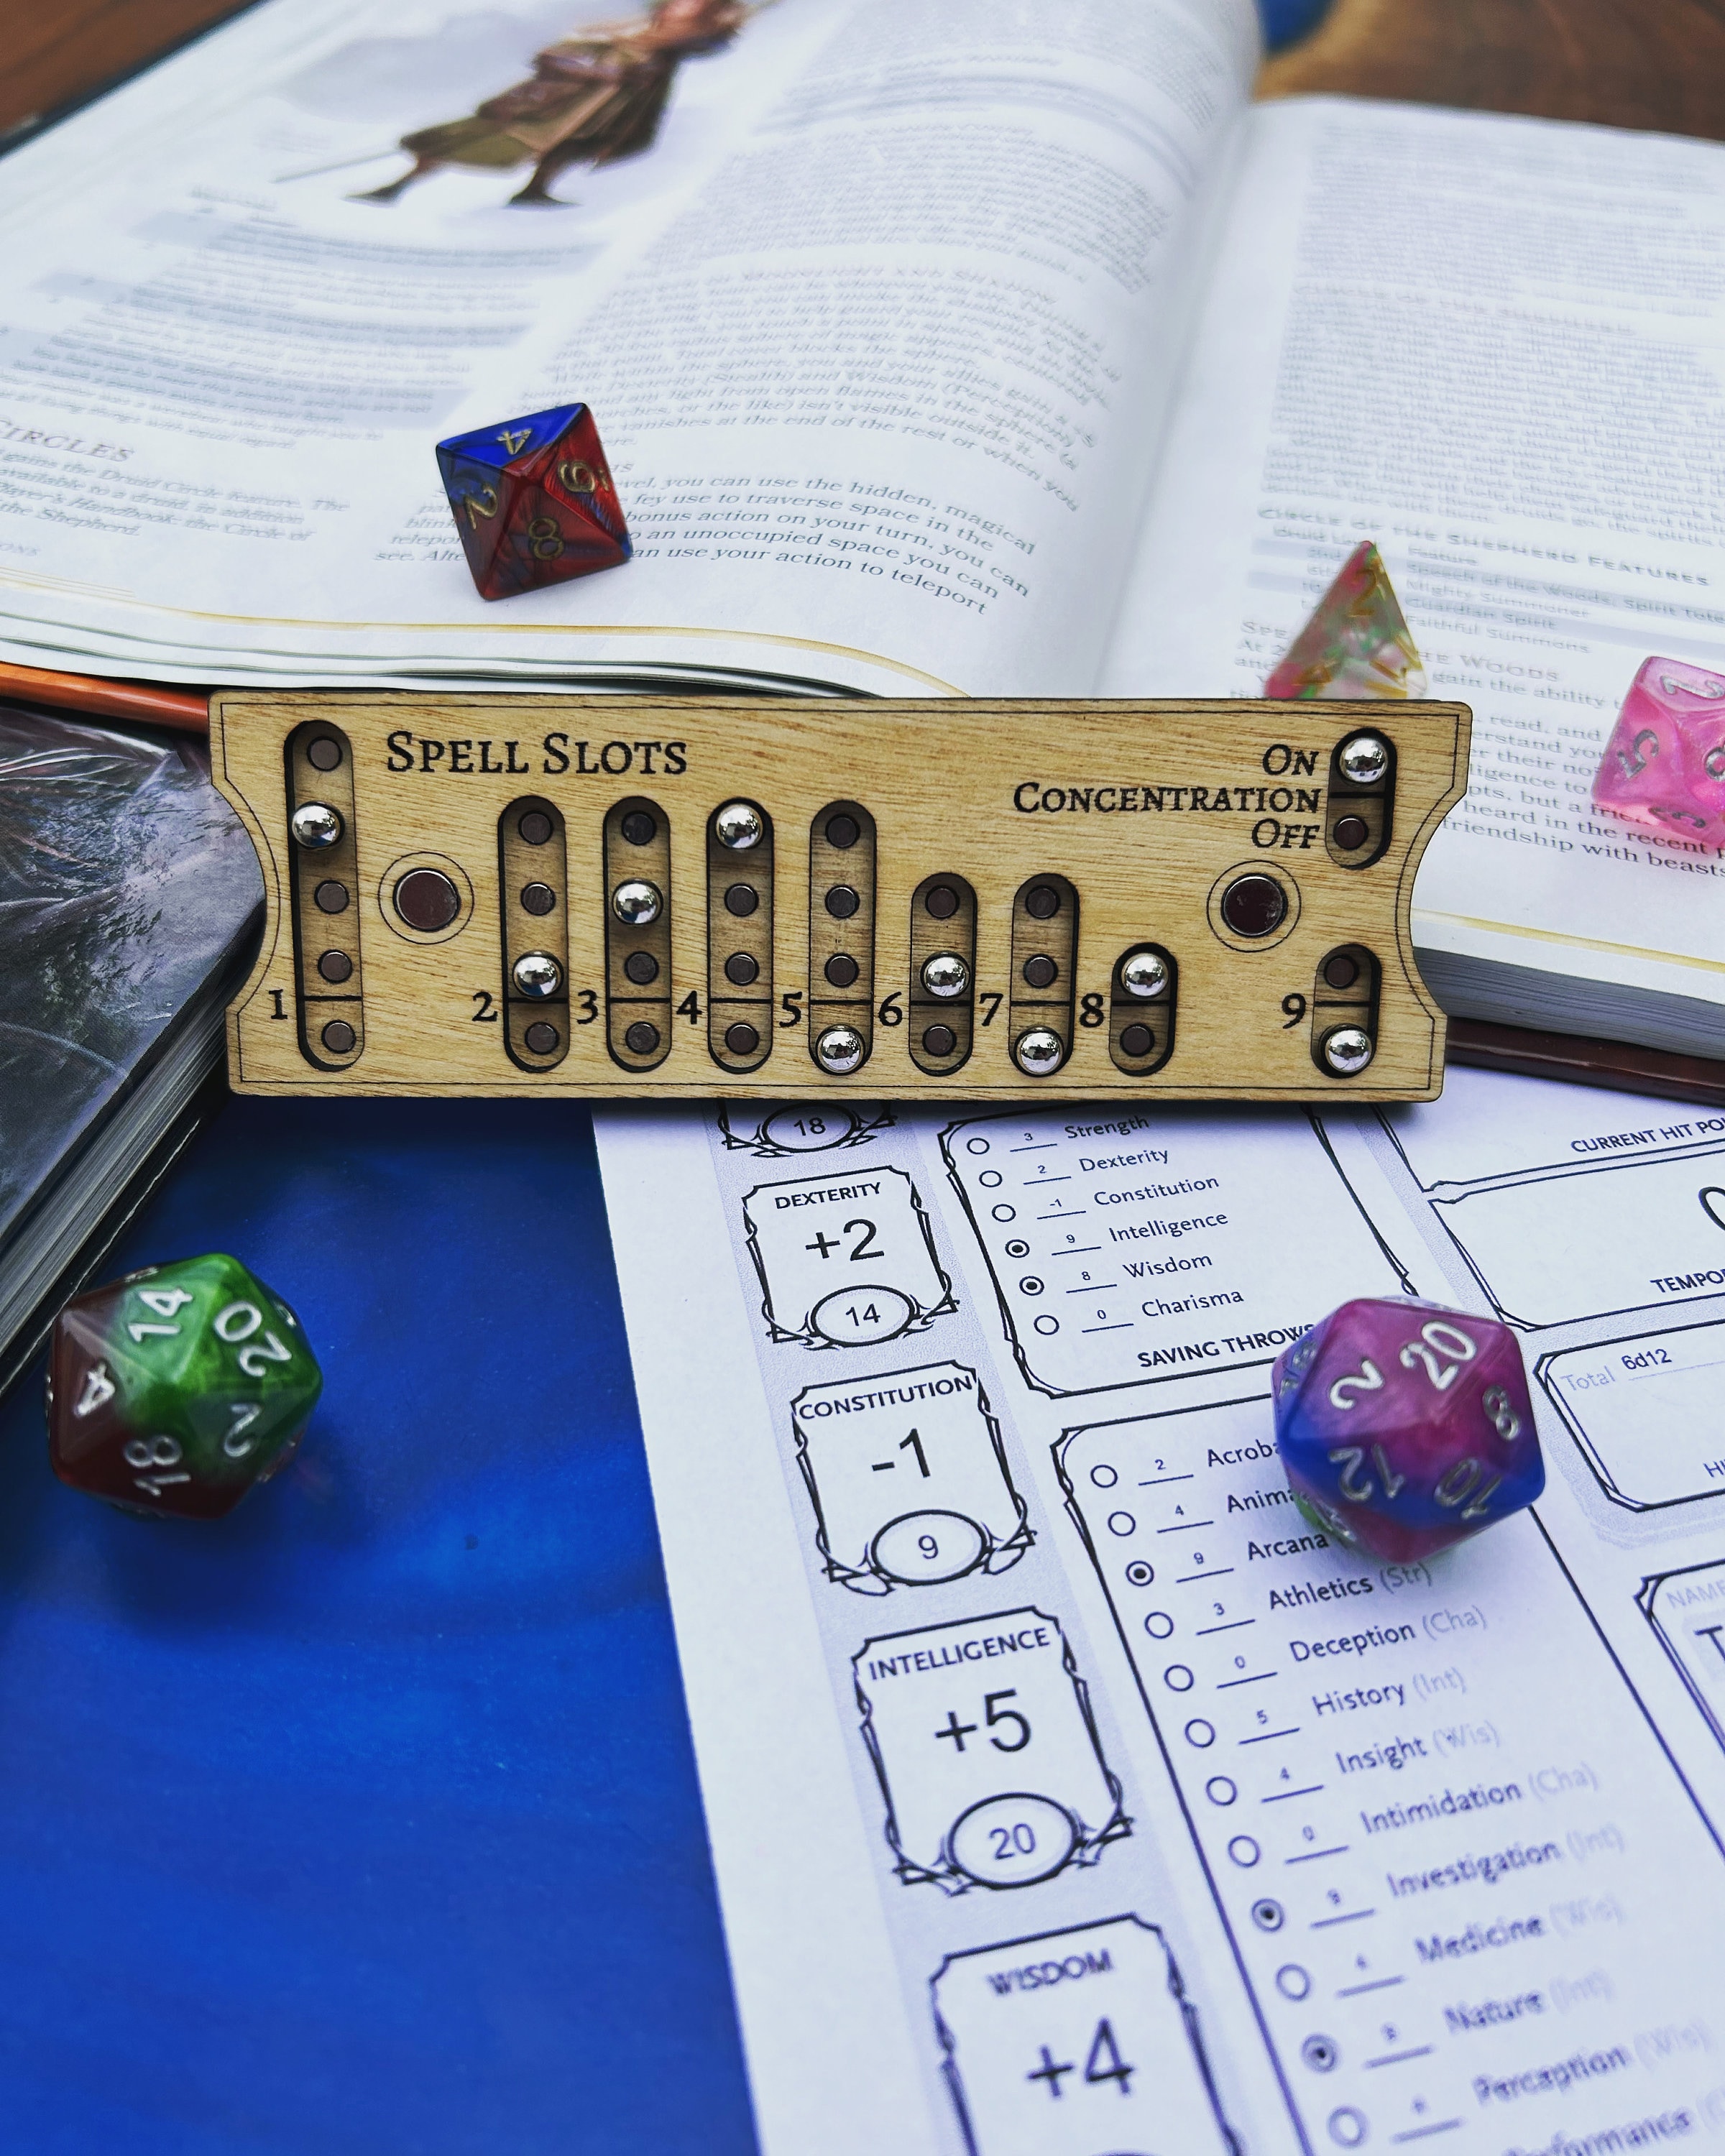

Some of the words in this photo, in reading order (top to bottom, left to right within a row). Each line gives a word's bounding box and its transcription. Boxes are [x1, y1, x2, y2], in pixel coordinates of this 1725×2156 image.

[837, 385, 909, 402] flames
[944, 396, 982, 416] the
[495, 428, 534, 456] 4
[851, 400, 924, 420] visible
[927, 413, 1011, 446] outside
[742, 415, 778, 426] the
[783, 415, 826, 426] end
[859, 417, 896, 433] the
[901, 423, 947, 443] rest
[983, 445, 1043, 482] when
[463, 485, 498, 530] 2
[632, 493, 667, 507] fey
[671, 494, 712, 505] use
[717, 494, 741, 505] to
[745, 494, 845, 510] traverse
[849, 502, 921, 524] space
[925, 516, 949, 534] in
[957, 528, 995, 553] the
[661, 477, 705, 490] you
[709, 476, 751, 487] can
[757, 477, 799, 488] use
[804, 477, 843, 492] the
[849, 481, 937, 511] hidden,
[944, 504, 1037, 556] magical
[528, 516, 565, 561] 8
[624, 510, 693, 524] bonus
[696, 509, 770, 522] action
[776, 512, 807, 525] on
[809, 517, 870, 532] your
[875, 524, 934, 550] turn,
[938, 543, 985, 569] you
[989, 566, 1031, 599] can
[1447, 534, 1578, 564] SHEPHERD
[1588, 554, 1710, 586] FEATURES
[647, 530, 676, 540] an
[682, 529, 824, 546] unoccupied
[827, 536, 901, 560] space
[902, 553, 952, 576] you
[956, 571, 1000, 600] can
[666, 547, 709, 558] use
[709, 548, 773, 562] your
[774, 551, 853, 571] action
[860, 561, 884, 576] to
[891, 568, 989, 616] teleport
[1405, 614, 1479, 637] Faithful
[1486, 625, 1593, 654] Summons
[1459, 653, 1562, 683] WOODS
[1432, 672, 1484, 689] gain
[1489, 678, 1528, 695] the
[1533, 686, 1607, 709] ability
[1557, 725, 1604, 743] and
[1497, 750, 1558, 771] their
[1520, 791, 1563, 810] but
[1564, 780, 1587, 795] to
[1443, 816, 1574, 854] friendship
[1581, 837, 1639, 863] with
[1463, 799, 1537, 825] heard
[1545, 815, 1570, 831] in
[1578, 821, 1619, 839] the
[1627, 831, 1708, 856] recent
[270, 989, 288, 1021] 1
[472, 992, 499, 1023] 2
[576, 990, 599, 1026] 3
[676, 990, 703, 1026] 4
[778, 991, 804, 1028] 5
[878, 991, 903, 1028] 6
[979, 992, 1005, 1028] 7
[1080, 992, 1105, 1028] 8
[1280, 993, 1307, 1030] 9
[794, 1117, 827, 1137] 18
[1024, 1132, 1034, 1142] 3
[1064, 1115, 1150, 1141] Strength
[1571, 1129, 1655, 1154] CURRENT
[1664, 1123, 1693, 1138] HIT
[1038, 1164, 1046, 1175] 2
[1079, 1147, 1169, 1173] Dexterity
[775, 1181, 882, 1210] DEXTERITY
[1049, 1198, 1062, 1209] -1
[1093, 1175, 1220, 1207] Constitution
[805, 1218, 886, 1262] +2
[1065, 1233, 1076, 1245] 9
[1108, 1211, 1229, 1243] Intelligence
[1082, 1270, 1092, 1282] 8
[1122, 1253, 1213, 1280] Wisdom
[126, 1286, 193, 1342] 14
[845, 1303, 882, 1327] 14
[1096, 1309, 1108, 1322] 0
[1141, 1289, 1245, 1319] Charisma
[213, 1301, 293, 1377] 20
[1138, 1341, 1220, 1368] SAVING
[1399, 1320, 1478, 1391] 20
[75, 1363, 116, 1419] 4
[1329, 1358, 1384, 1410] 2
[1561, 1363, 1616, 1393] Total
[1622, 1348, 1673, 1372] 6d12
[799, 1374, 972, 1420] CONSTITUTION
[1481, 1385, 1520, 1441] 8
[224, 1403, 262, 1458] 2
[871, 1427, 932, 1478] -1
[122, 1434, 192, 1498] 18
[1154, 1457, 1167, 1471] 2
[1328, 1443, 1405, 1502] 12
[1174, 1504, 1184, 1516] 4
[917, 1534, 939, 1560] 9
[1193, 1552, 1205, 1565] 9
[1247, 1531, 1329, 1562] Arcana
[1214, 1602, 1225, 1616] 3
[1269, 1577, 1374, 1611] Athletics
[1379, 1562, 1432, 1594] (Str)
[868, 1626, 1052, 1681] INTELLIGENCE
[1235, 1655, 1246, 1669] 0
[1289, 1622, 1415, 1663] Deception
[1422, 1606, 1488, 1640] (Cha)
[1311, 1679, 1407, 1717] History
[1412, 1667, 1468, 1703] (Int)
[934, 1687, 1032, 1753] +5
[1335, 1734, 1428, 1775] Insight
[1432, 1720, 1501, 1759] (Wis)
[1360, 1780, 1522, 1835] Intimidation
[1528, 1759, 1600, 1797] (Cha)
[988, 1823, 1037, 1861] 20
[1386, 1840, 1562, 1899] Investigation
[1414, 1915, 1545, 1965] Medicine
[985, 1948, 1114, 1996] WISDOM
[1443, 1991, 1545, 2035] Nature
[1026, 2017, 1136, 2099] +4
[1472, 2042, 1632, 2107] Perception
